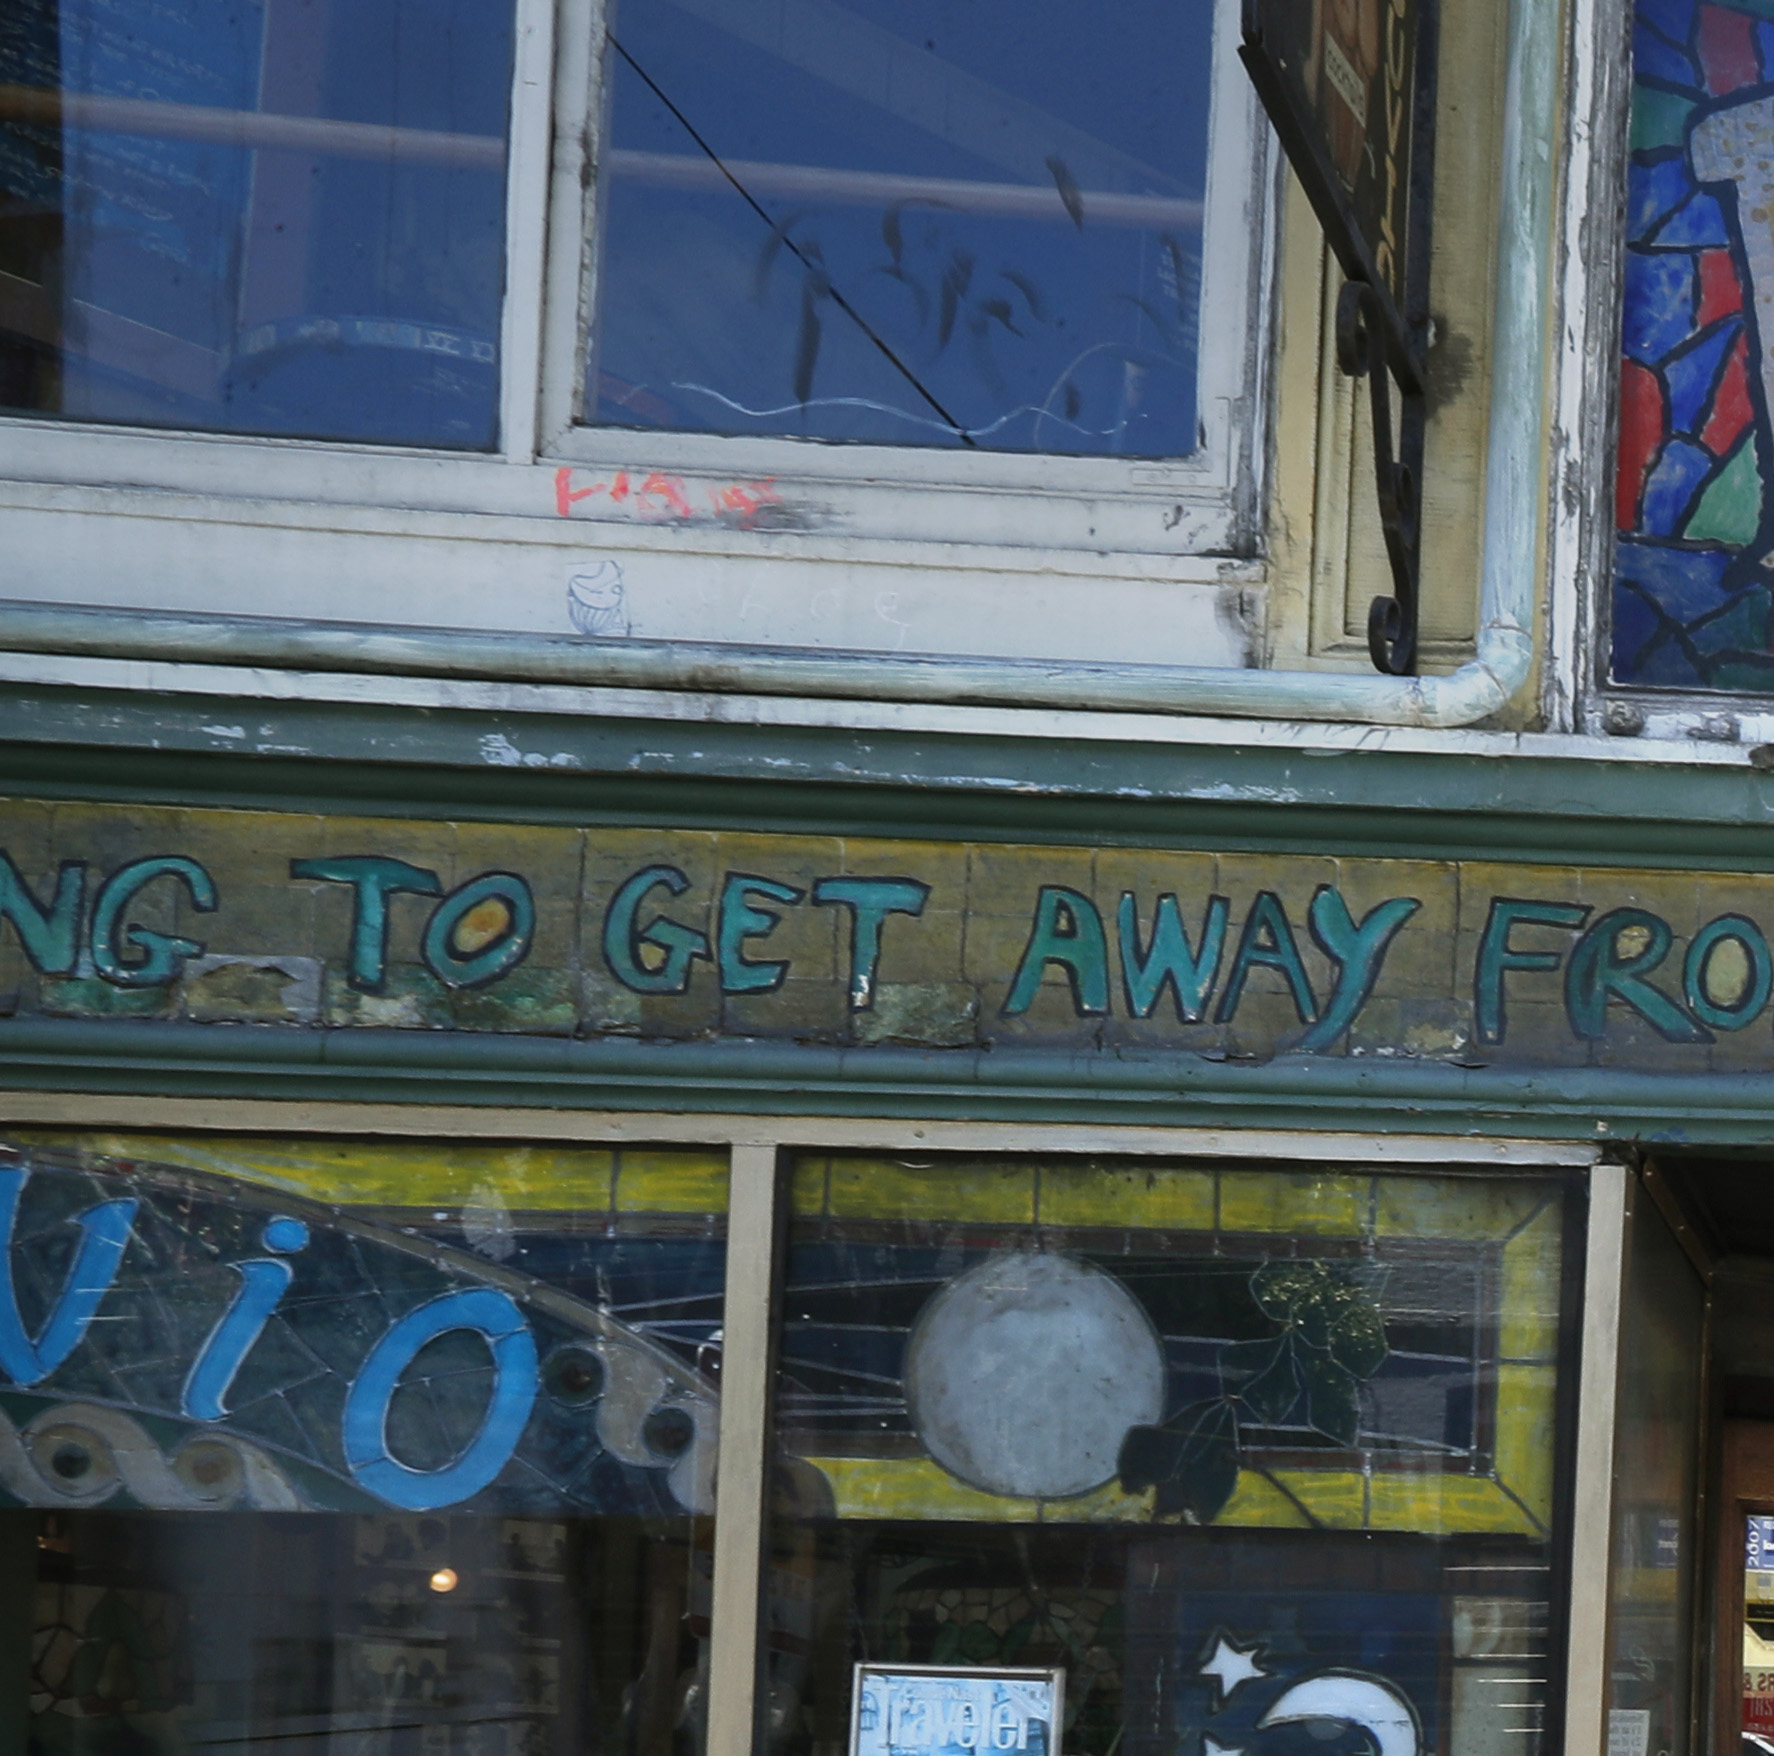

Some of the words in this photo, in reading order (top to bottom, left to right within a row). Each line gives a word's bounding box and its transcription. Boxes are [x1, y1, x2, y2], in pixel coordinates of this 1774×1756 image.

[290, 854, 536, 990] TO
[603, 864, 931, 1012] GET
[1004, 883, 1421, 1053] AWAY
[1747, 1519, 1760, 1567] 2007
[875, 1685, 1029, 1750] Traveler
